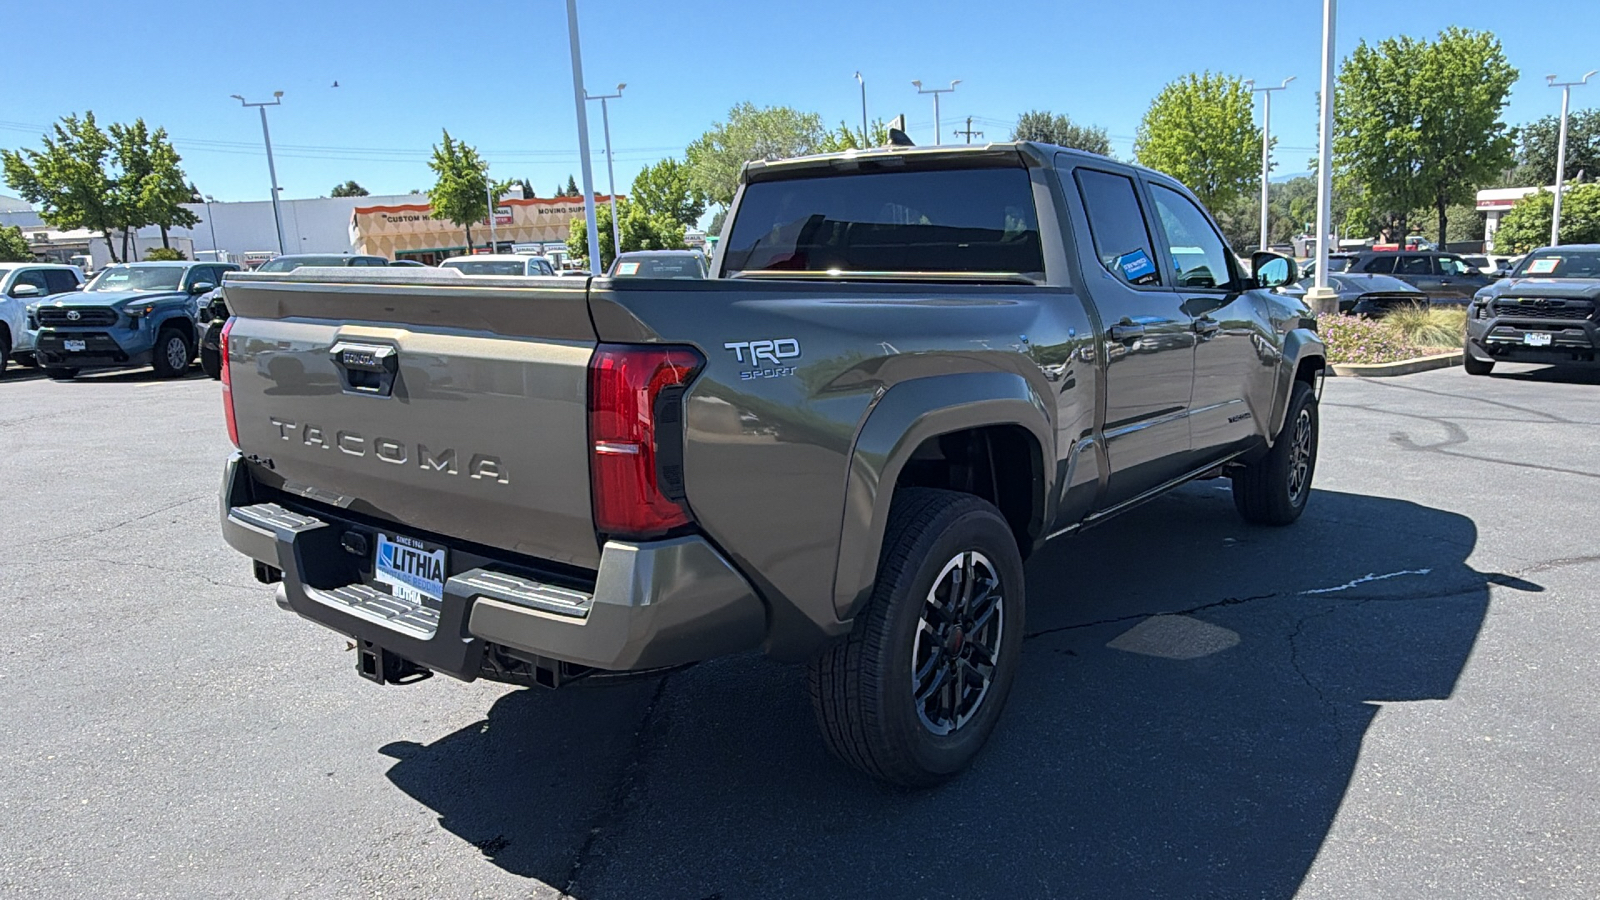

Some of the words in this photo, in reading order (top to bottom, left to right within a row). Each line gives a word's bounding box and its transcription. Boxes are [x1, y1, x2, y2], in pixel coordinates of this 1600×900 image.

[724, 338, 800, 367] TRD
[740, 366, 797, 380] SPORT
[269, 416, 510, 484] TACOMA
[396, 535, 411, 546] SINCE
[392, 546, 444, 584] LITHIA
